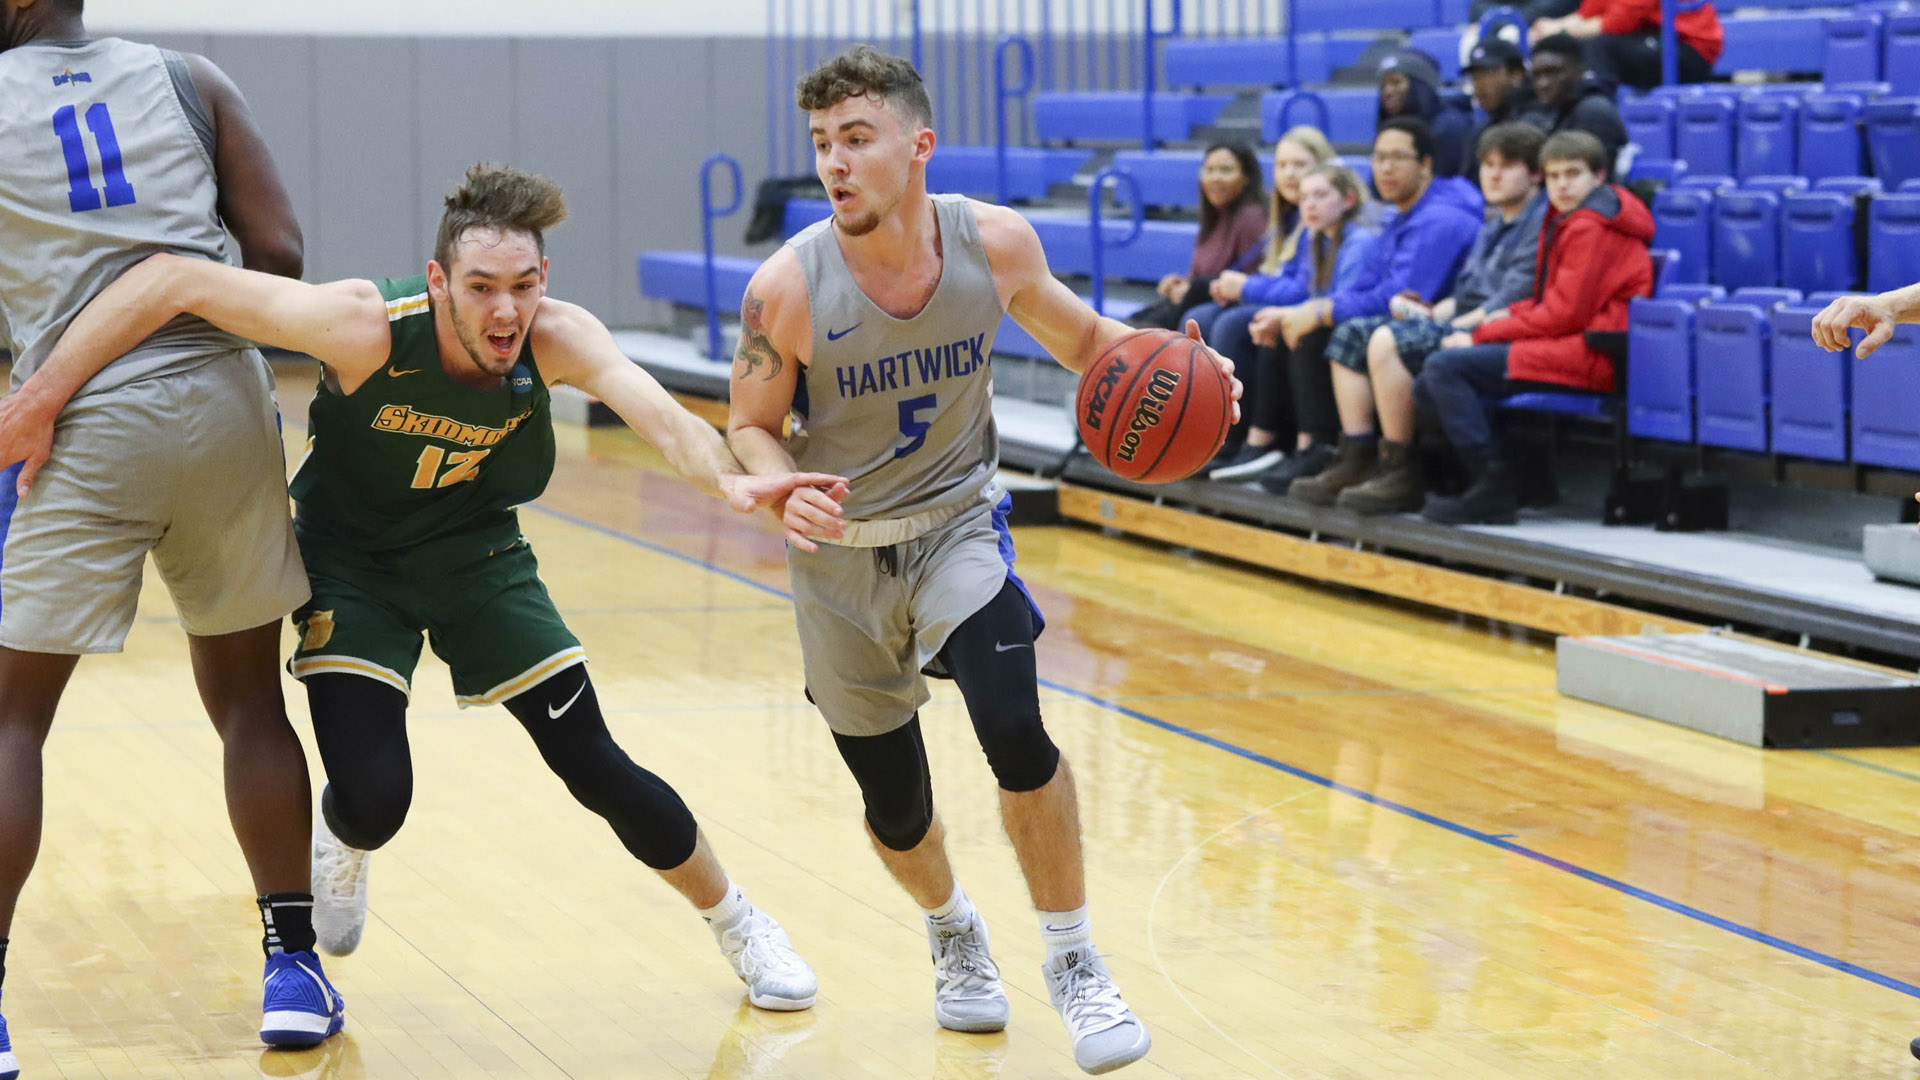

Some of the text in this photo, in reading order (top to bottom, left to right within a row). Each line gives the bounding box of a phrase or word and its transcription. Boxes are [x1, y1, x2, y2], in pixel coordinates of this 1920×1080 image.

[52, 102, 136, 212] 11
[836, 332, 985, 398] HARTWICK
[1086, 357, 1129, 431] NCAA
[894, 393, 937, 459] 5
[1115, 368, 1182, 462] Wilson
[410, 444, 491, 489] 12
